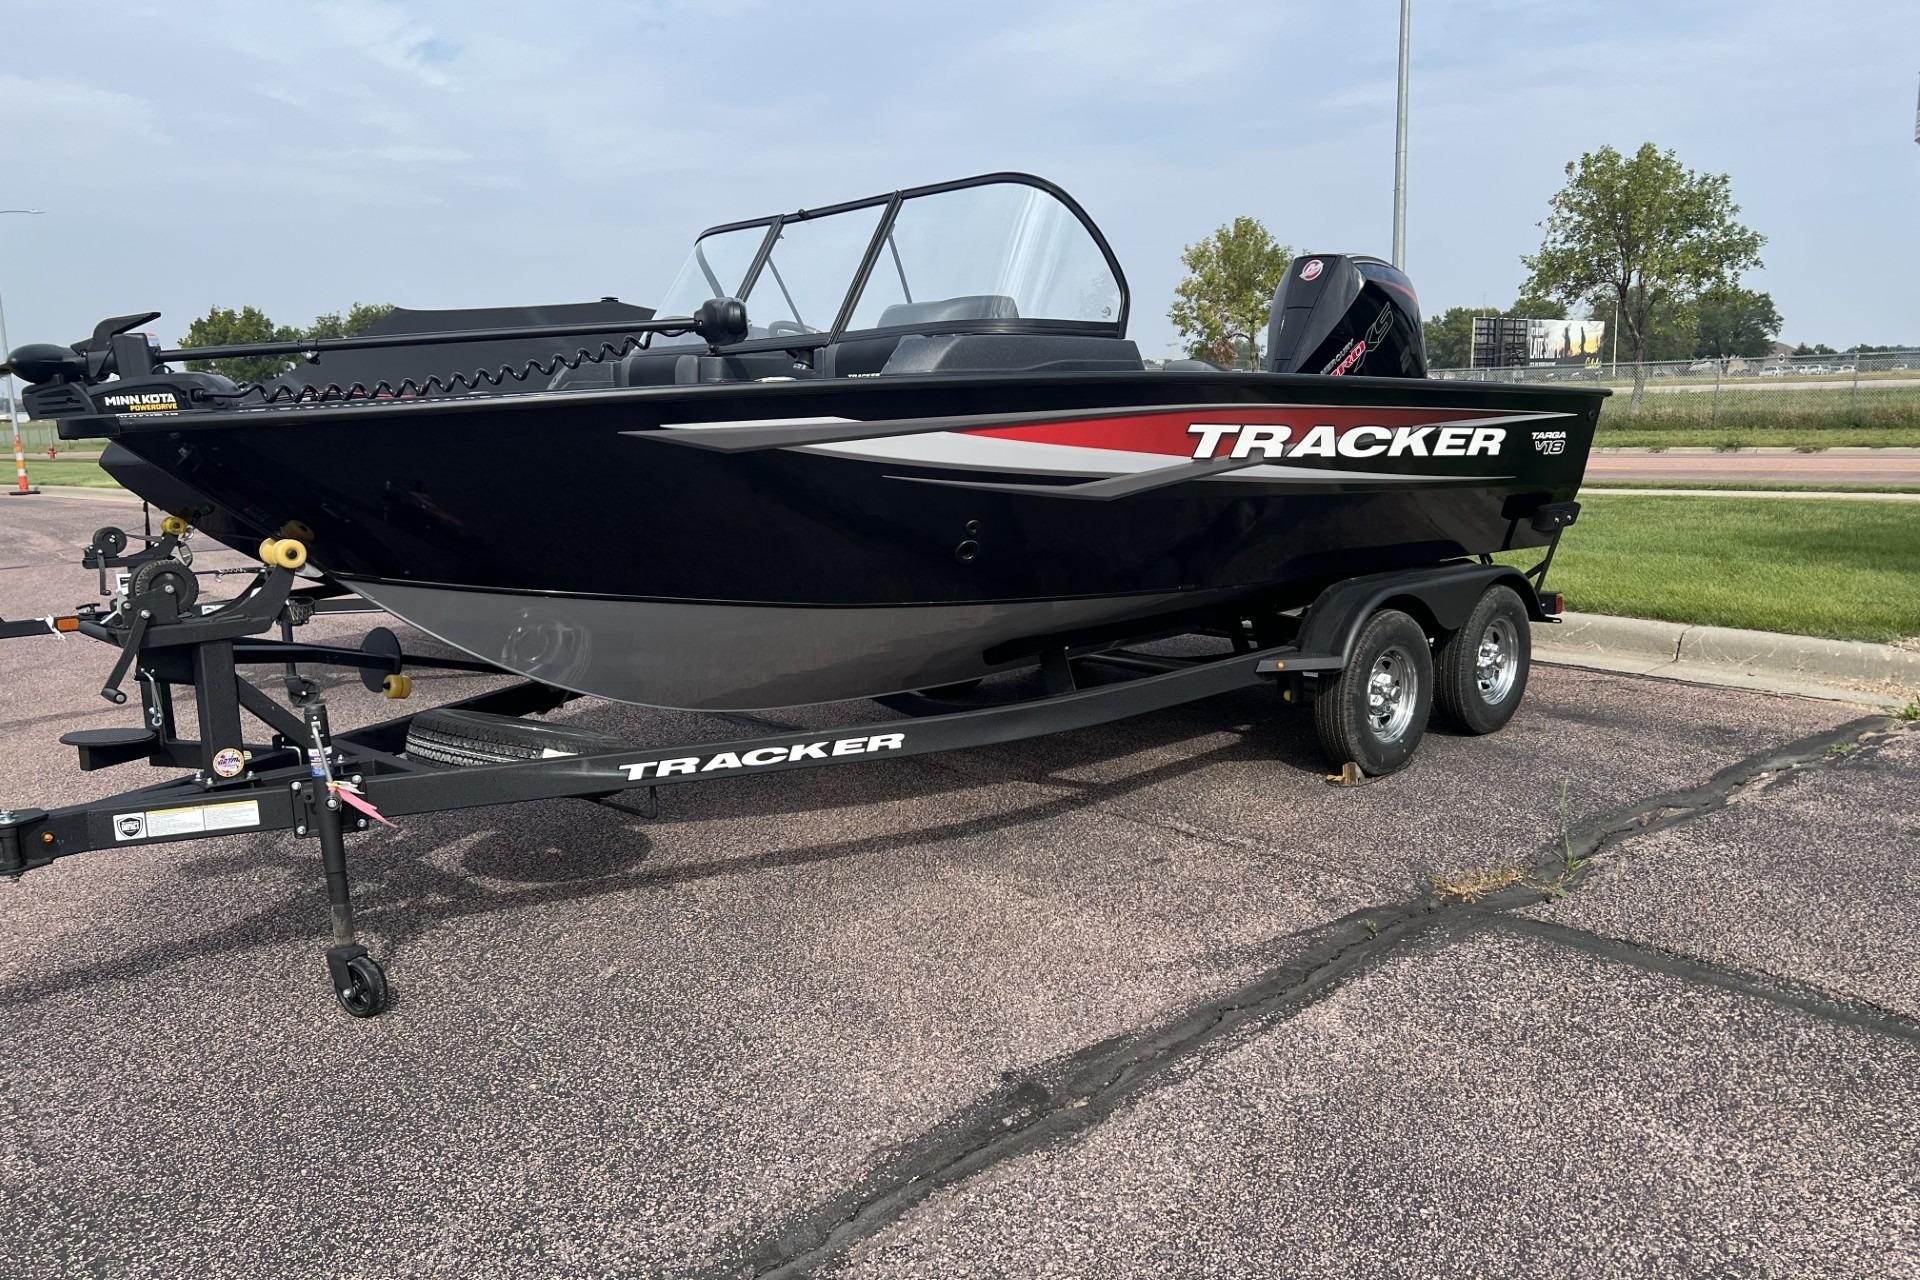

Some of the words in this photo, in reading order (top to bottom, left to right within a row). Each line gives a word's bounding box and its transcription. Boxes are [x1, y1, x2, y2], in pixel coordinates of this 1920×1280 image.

[104, 395, 141, 406] MINN
[141, 393, 176, 404] KOTA
[130, 403, 178, 412] POWERDRIVE
[1187, 424, 1507, 459] TRACKER
[1531, 431, 1567, 440] TARGA
[1535, 440, 1566, 455] V18
[618, 733, 905, 781] TRACKER
